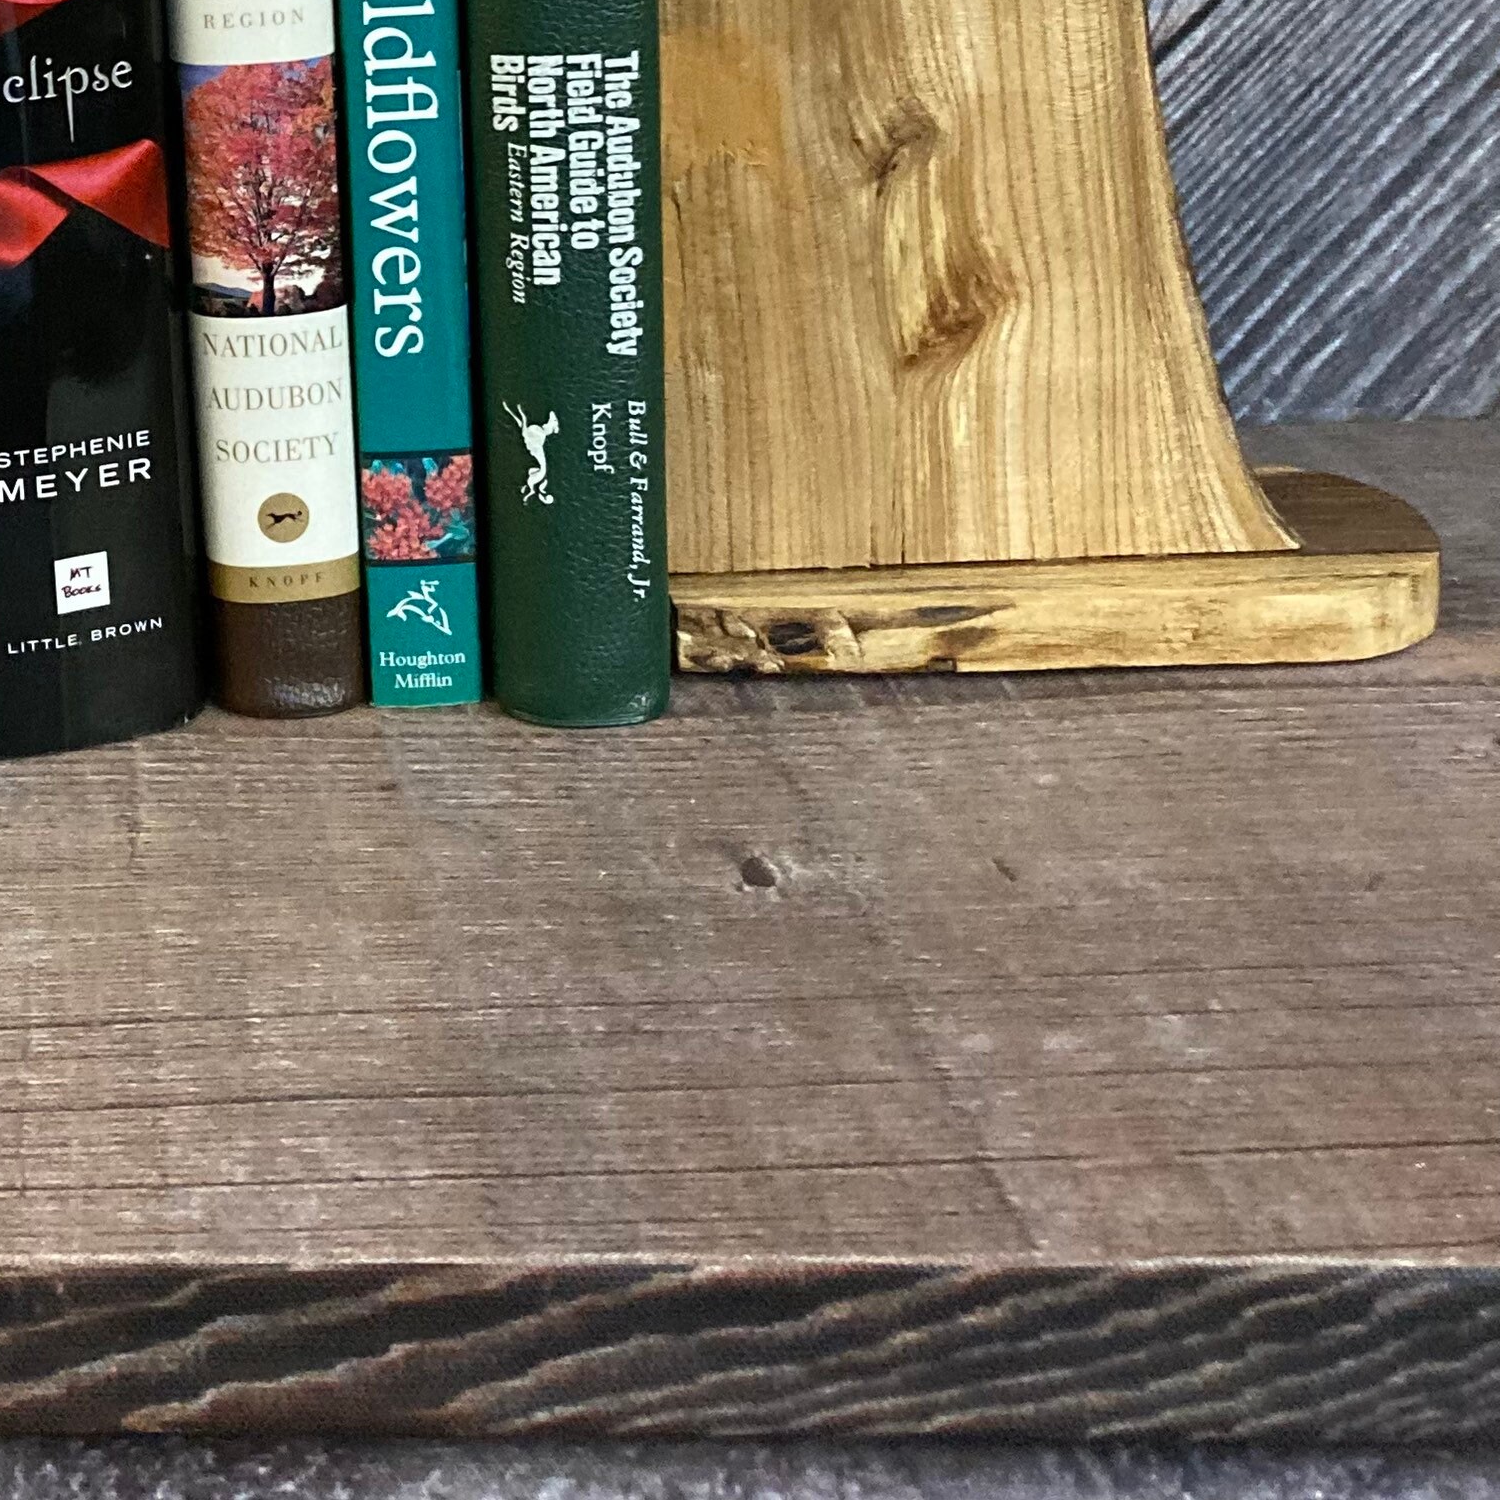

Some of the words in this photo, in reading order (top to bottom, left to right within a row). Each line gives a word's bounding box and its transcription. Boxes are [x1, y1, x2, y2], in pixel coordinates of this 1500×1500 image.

[203, 8, 305, 29] REGION
[490, 54, 526, 132] Birds
[527, 54, 565, 138] North
[566, 53, 603, 124] Field
[604, 50, 639, 109] The
[507, 142, 528, 223] Eastern
[568, 130, 605, 214] Guide
[605, 115, 641, 244] Audubon
[529, 145, 568, 286] American
[570, 218, 606, 250] to
[505, 232, 531, 304] Region
[606, 246, 644, 356] Society
[202, 325, 342, 358] NATIONAL
[206, 378, 343, 411] AUDUBON
[587, 402, 615, 474] Knopf
[628, 400, 648, 446] Bull
[216, 432, 339, 464] SOCIETY
[629, 452, 648, 470] &
[629, 477, 650, 569] Farrand,
[69, 566, 93, 581] MT
[249, 572, 325, 588] KNOPF
[627, 573, 650, 602] Jr.
[7, 634, 82, 655] LITTLE,
[91, 617, 163, 641] BROWN
[379, 651, 466, 669] Houghton
[394, 672, 453, 689] Mifflin
